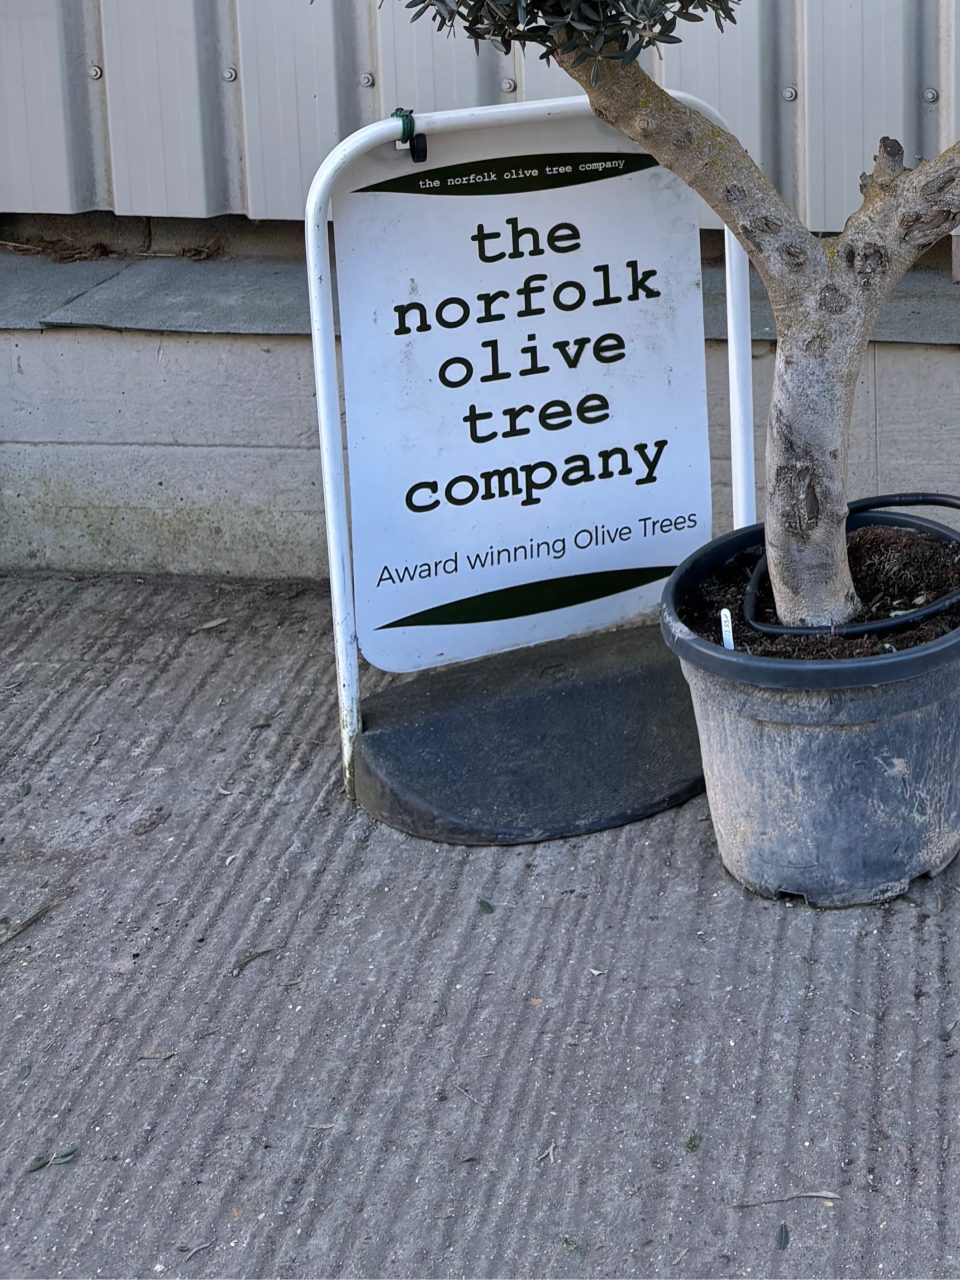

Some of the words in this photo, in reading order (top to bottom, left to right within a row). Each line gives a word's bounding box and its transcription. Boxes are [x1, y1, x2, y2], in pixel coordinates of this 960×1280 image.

[419, 178, 441, 189] the
[447, 171, 497, 186] norfolk
[503, 168, 539, 180] olive
[545, 165, 573, 175] tree
[578, 159, 625, 172] company
[470, 216, 581, 264] the
[393, 259, 662, 336] norfolk
[438, 332, 626, 389] olive
[462, 393, 610, 444] tree
[405, 439, 669, 514] company
[376, 551, 459, 588] Award
[466, 537, 567, 570] winning
[573, 524, 633, 551] Olive
[638, 511, 698, 539] Trees
